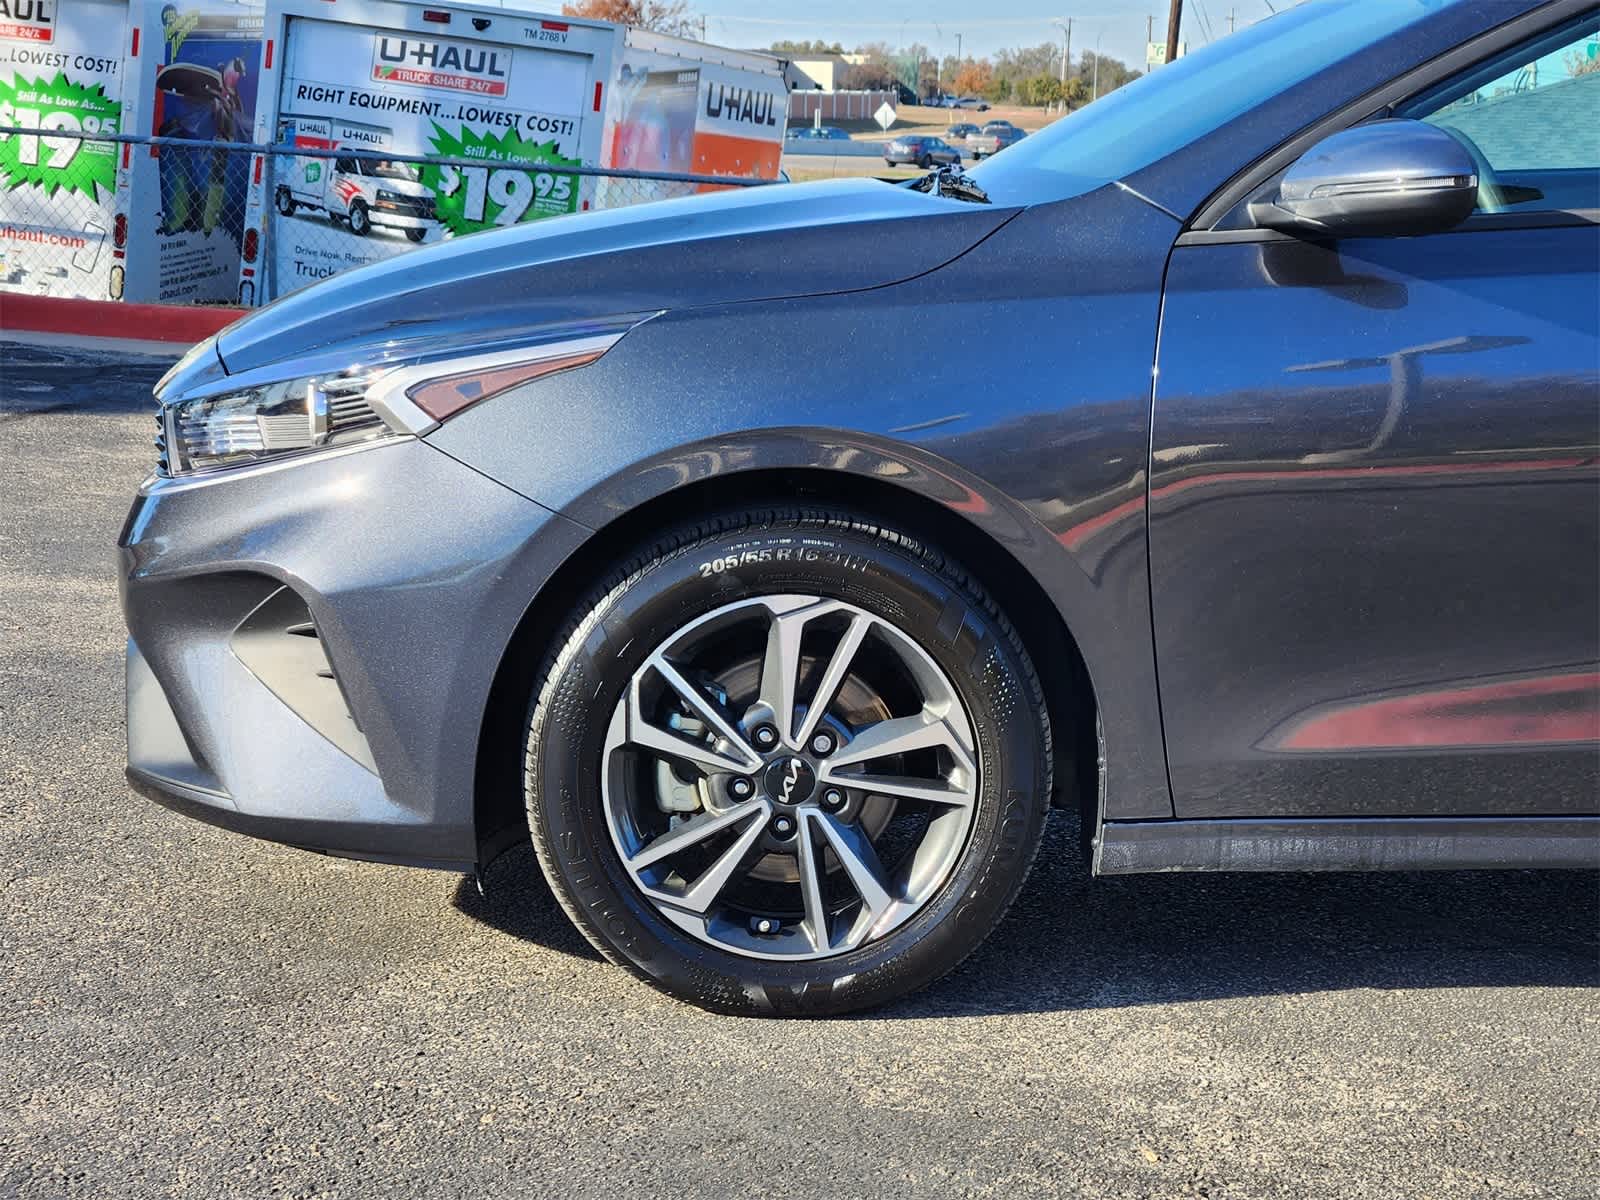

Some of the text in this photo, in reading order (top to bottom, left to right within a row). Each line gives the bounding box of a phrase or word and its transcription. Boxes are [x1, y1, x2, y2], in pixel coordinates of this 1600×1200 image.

[74, 55, 117, 74] COST!
[380, 38, 504, 76] U-HAUL
[396, 71, 490, 92] TRUCK SHARE 24/7
[17, 90, 37, 102] Still
[40, 94, 52, 104] As
[56, 96, 78, 107] Low
[706, 80, 776, 126] U-HAUL
[297, 85, 344, 104] RIGHT
[527, 115, 573, 136] COST!
[343, 128, 384, 145] U-HAUL
[464, 145, 486, 157] Still
[488, 149, 503, 160] As
[0, 226, 86, 248] uhaul.com
[699, 548, 772, 578] 205/55
